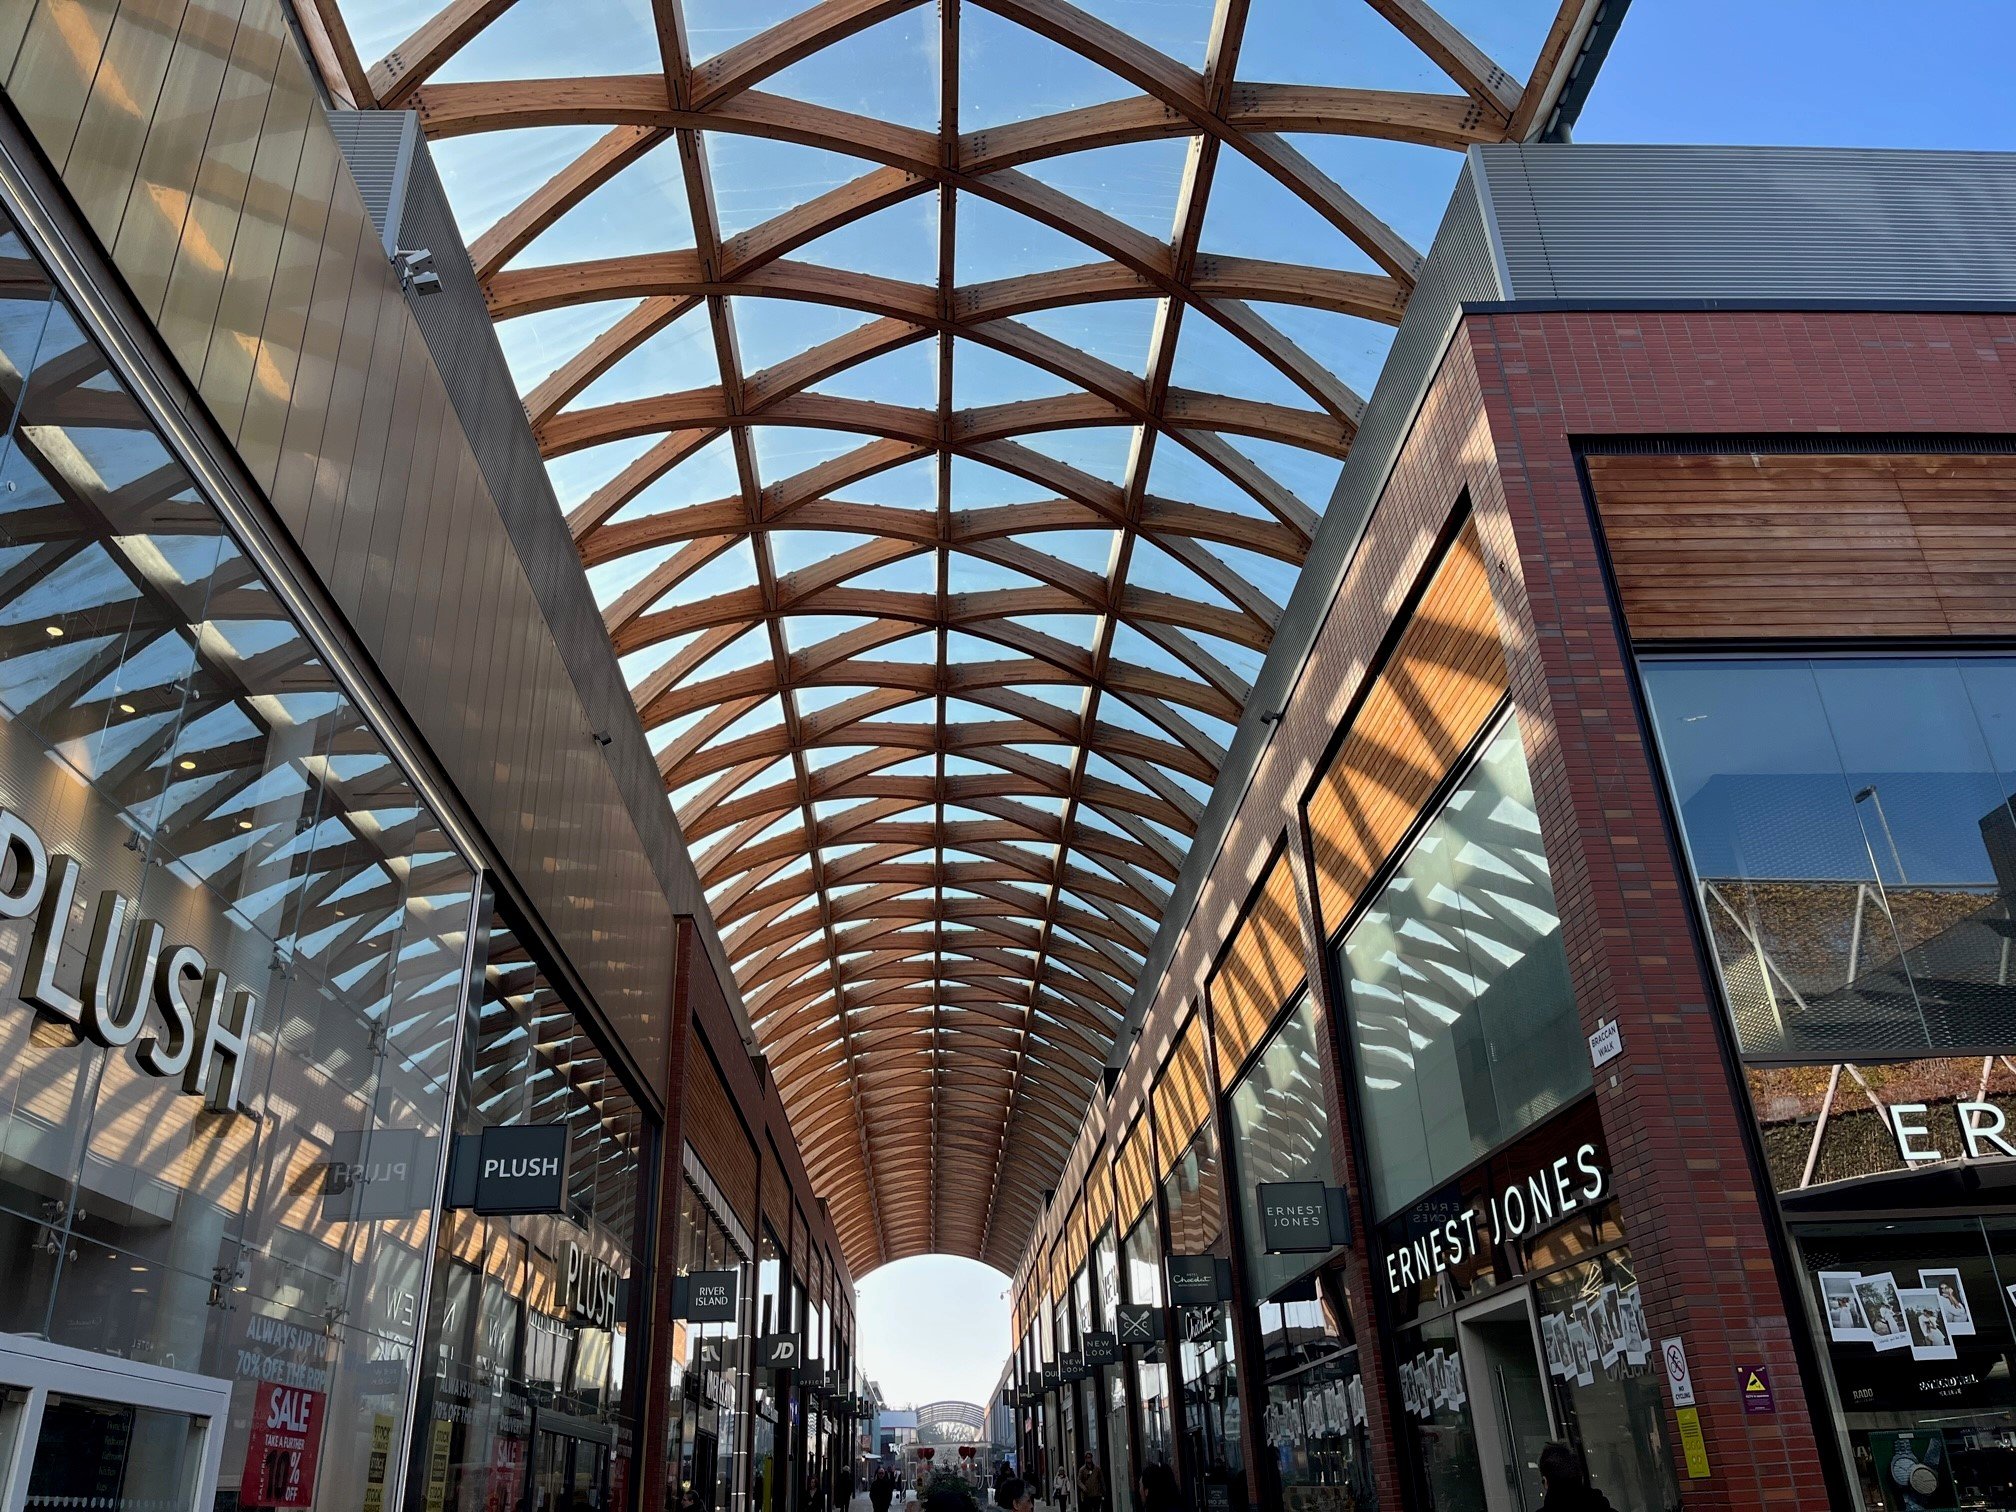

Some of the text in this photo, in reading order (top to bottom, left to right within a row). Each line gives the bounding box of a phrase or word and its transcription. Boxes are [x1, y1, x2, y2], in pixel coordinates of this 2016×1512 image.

[0, 808, 256, 1113] PLUSH
[1591, 1025, 1617, 1048] BRACCAN
[1597, 1041, 1615, 1058] WALK
[484, 1157, 558, 1178] PLUSH
[1266, 1204, 1323, 1217] ERNEST
[1387, 1144, 1602, 1294] ERNEST JONES
[1273, 1216, 1320, 1228] JONES
[565, 1240, 618, 1333] PLUSH
[699, 1286, 725, 1296] RIVER
[695, 1296, 729, 1306] ISLAND
[246, 1315, 328, 1358] ALWAYS UP TO
[771, 1342, 795, 1360] JD
[1085, 1349, 1112, 1357] LOOK
[235, 1349, 260, 1378] 70%
[262, 1356, 285, 1382] OFF
[1852, 1388, 1874, 1400] RADO
[267, 1387, 312, 1432] SALE
[265, 1434, 278, 1447] TAKE
[285, 1486, 298, 1501] OFF
